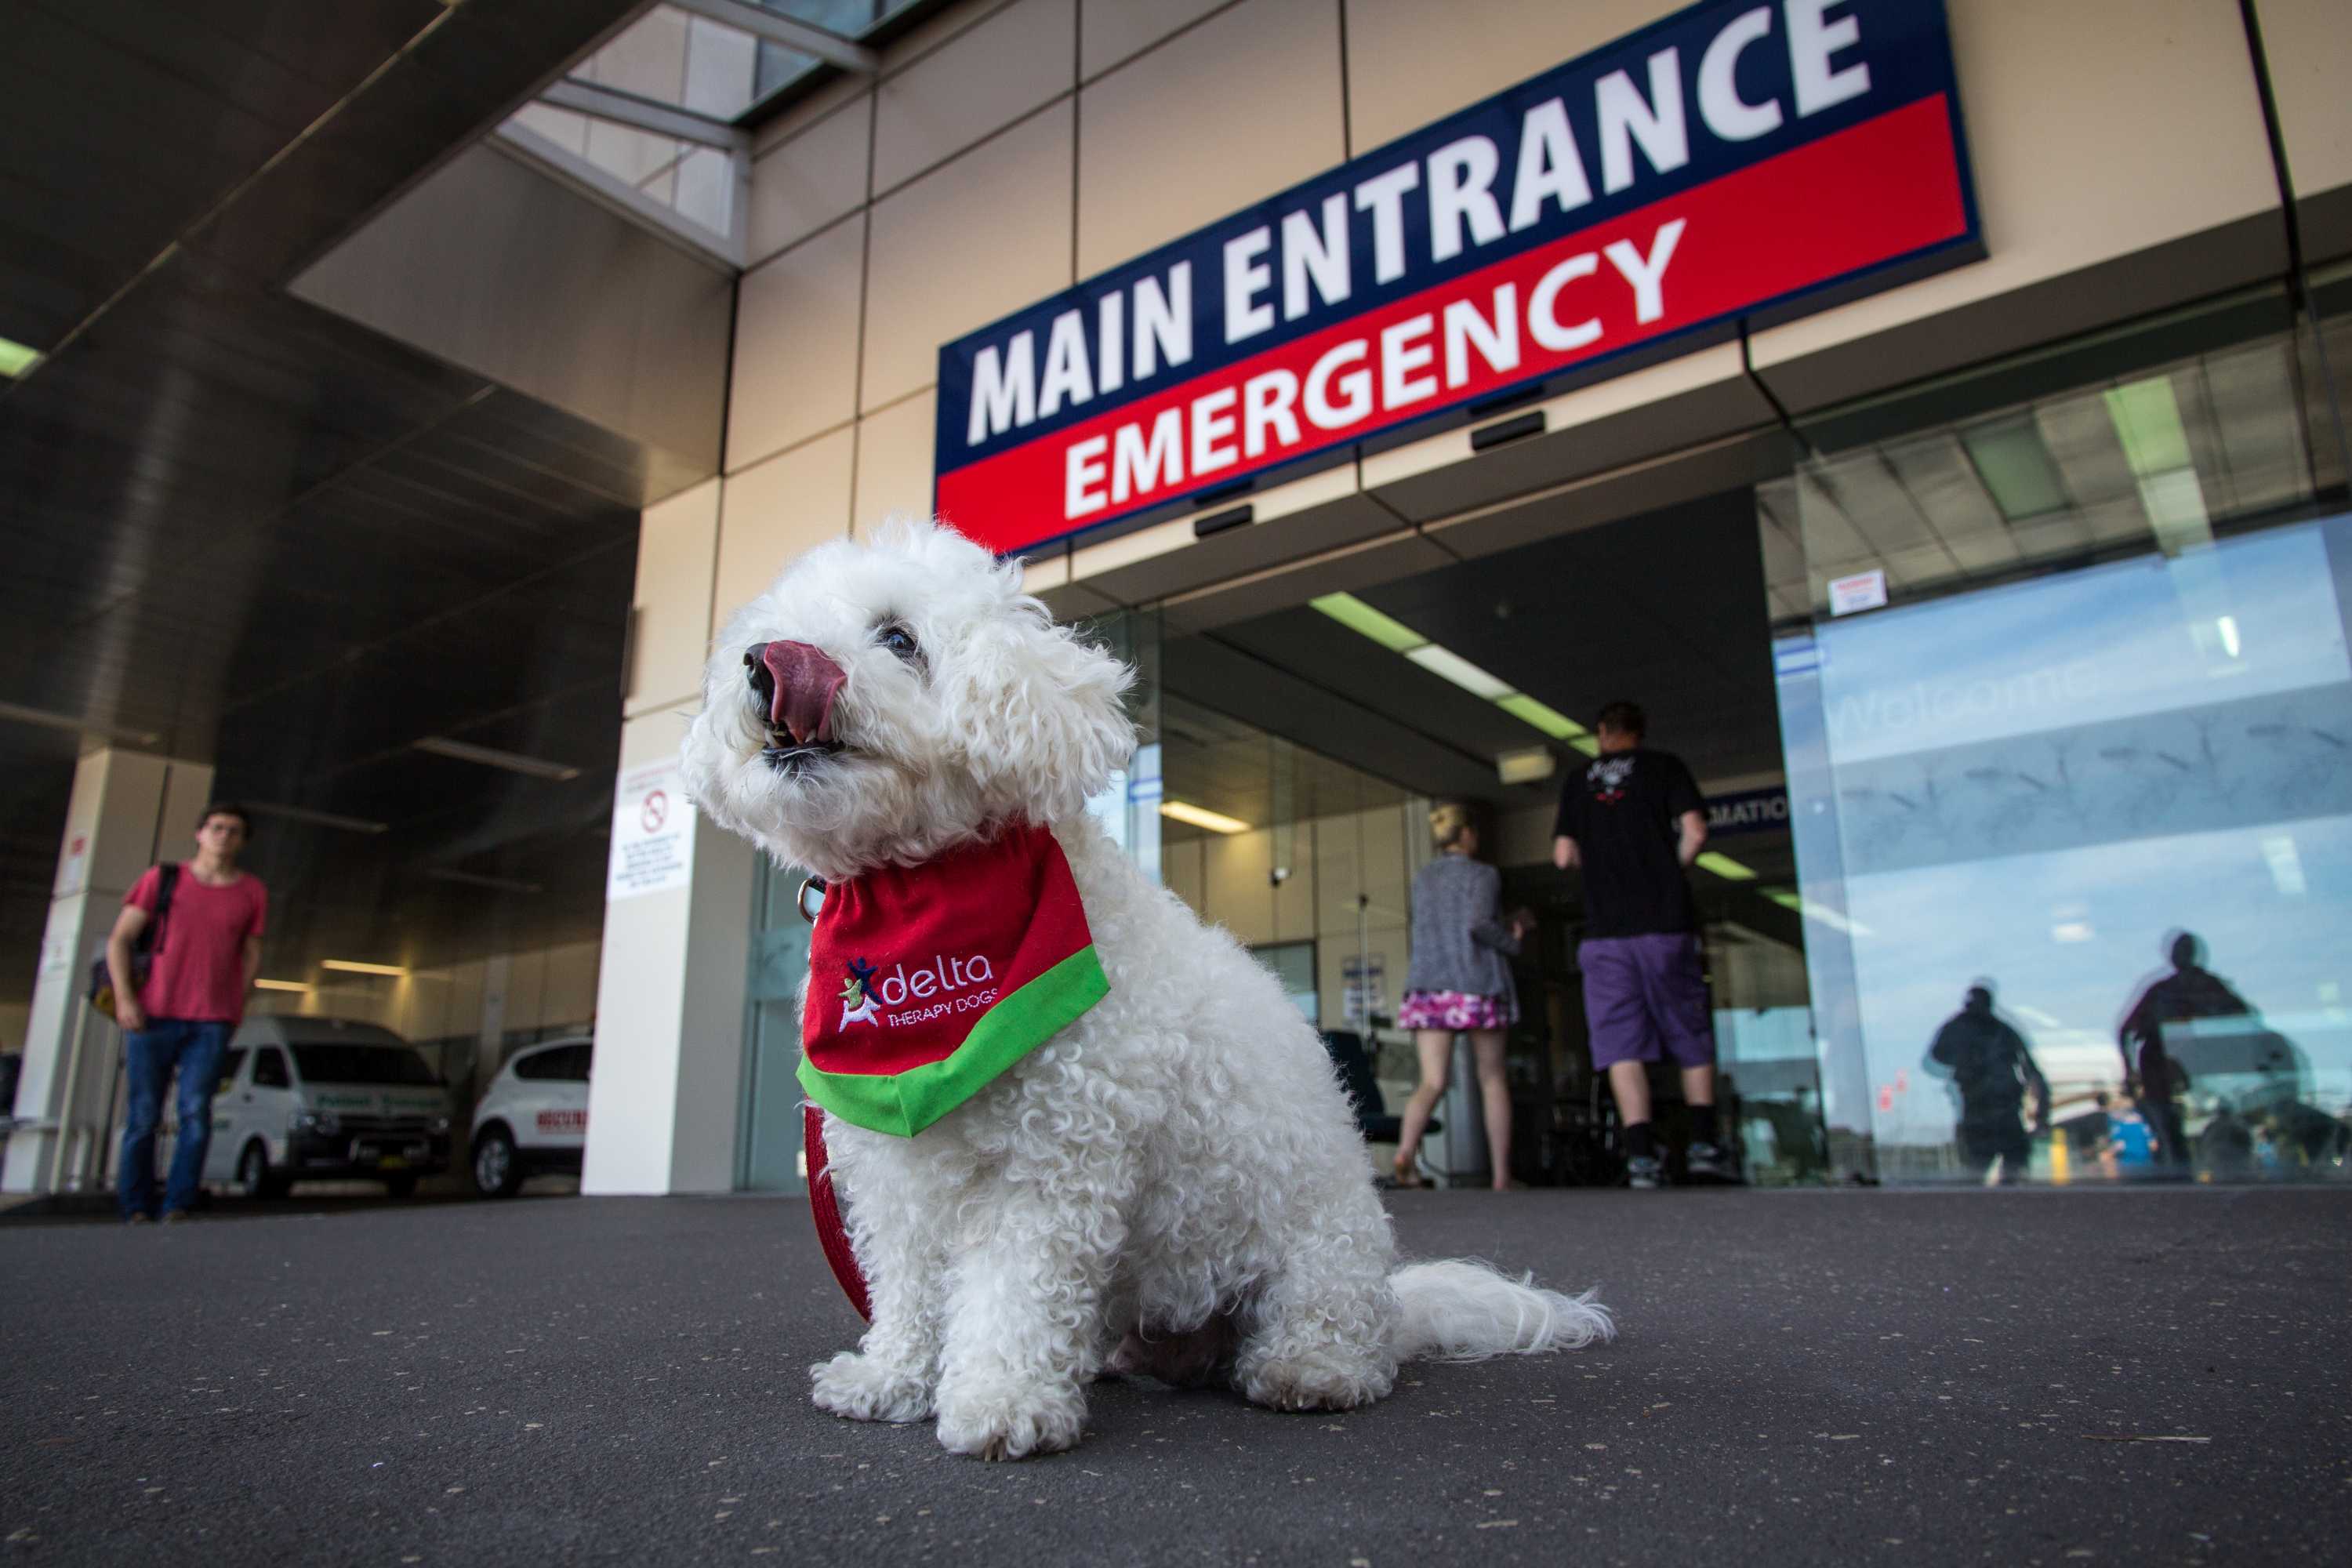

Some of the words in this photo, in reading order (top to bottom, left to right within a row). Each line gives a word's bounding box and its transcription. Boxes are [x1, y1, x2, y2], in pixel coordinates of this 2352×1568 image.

[966, 261, 1192, 446] MAIN
[1223, 0, 1871, 343] ENTRANCE
[1064, 219, 1687, 521] EMERGENCY
[1824, 661, 2101, 740] Welcome
[1707, 795, 1788, 828] MATIO
[881, 954, 994, 1006] delta
[887, 1001, 953, 1028] THERAPY
